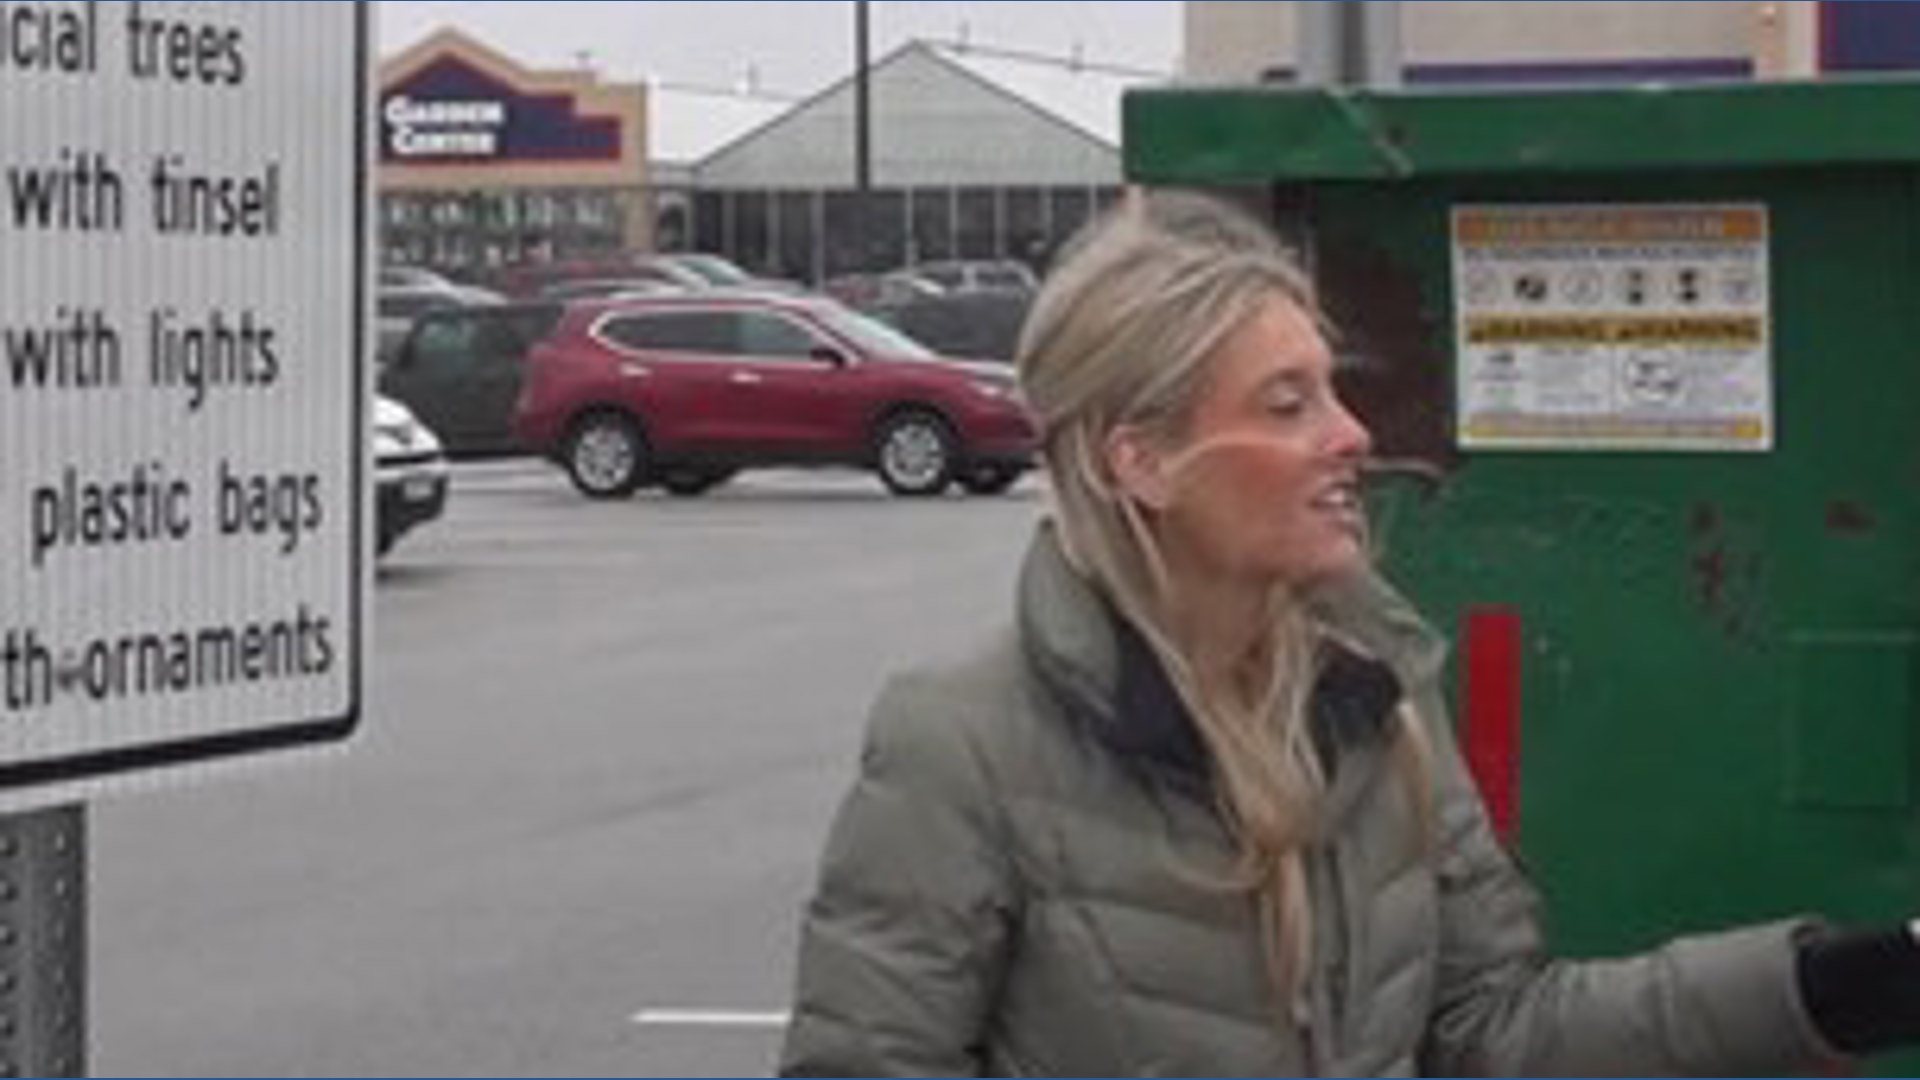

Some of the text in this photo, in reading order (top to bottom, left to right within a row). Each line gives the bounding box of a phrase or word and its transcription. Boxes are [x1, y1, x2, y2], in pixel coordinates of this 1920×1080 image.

[127, 1, 243, 84] trees
[7, 147, 279, 236] with tinsel
[5, 306, 279, 411] with lights
[31, 458, 323, 568] plastic bags
